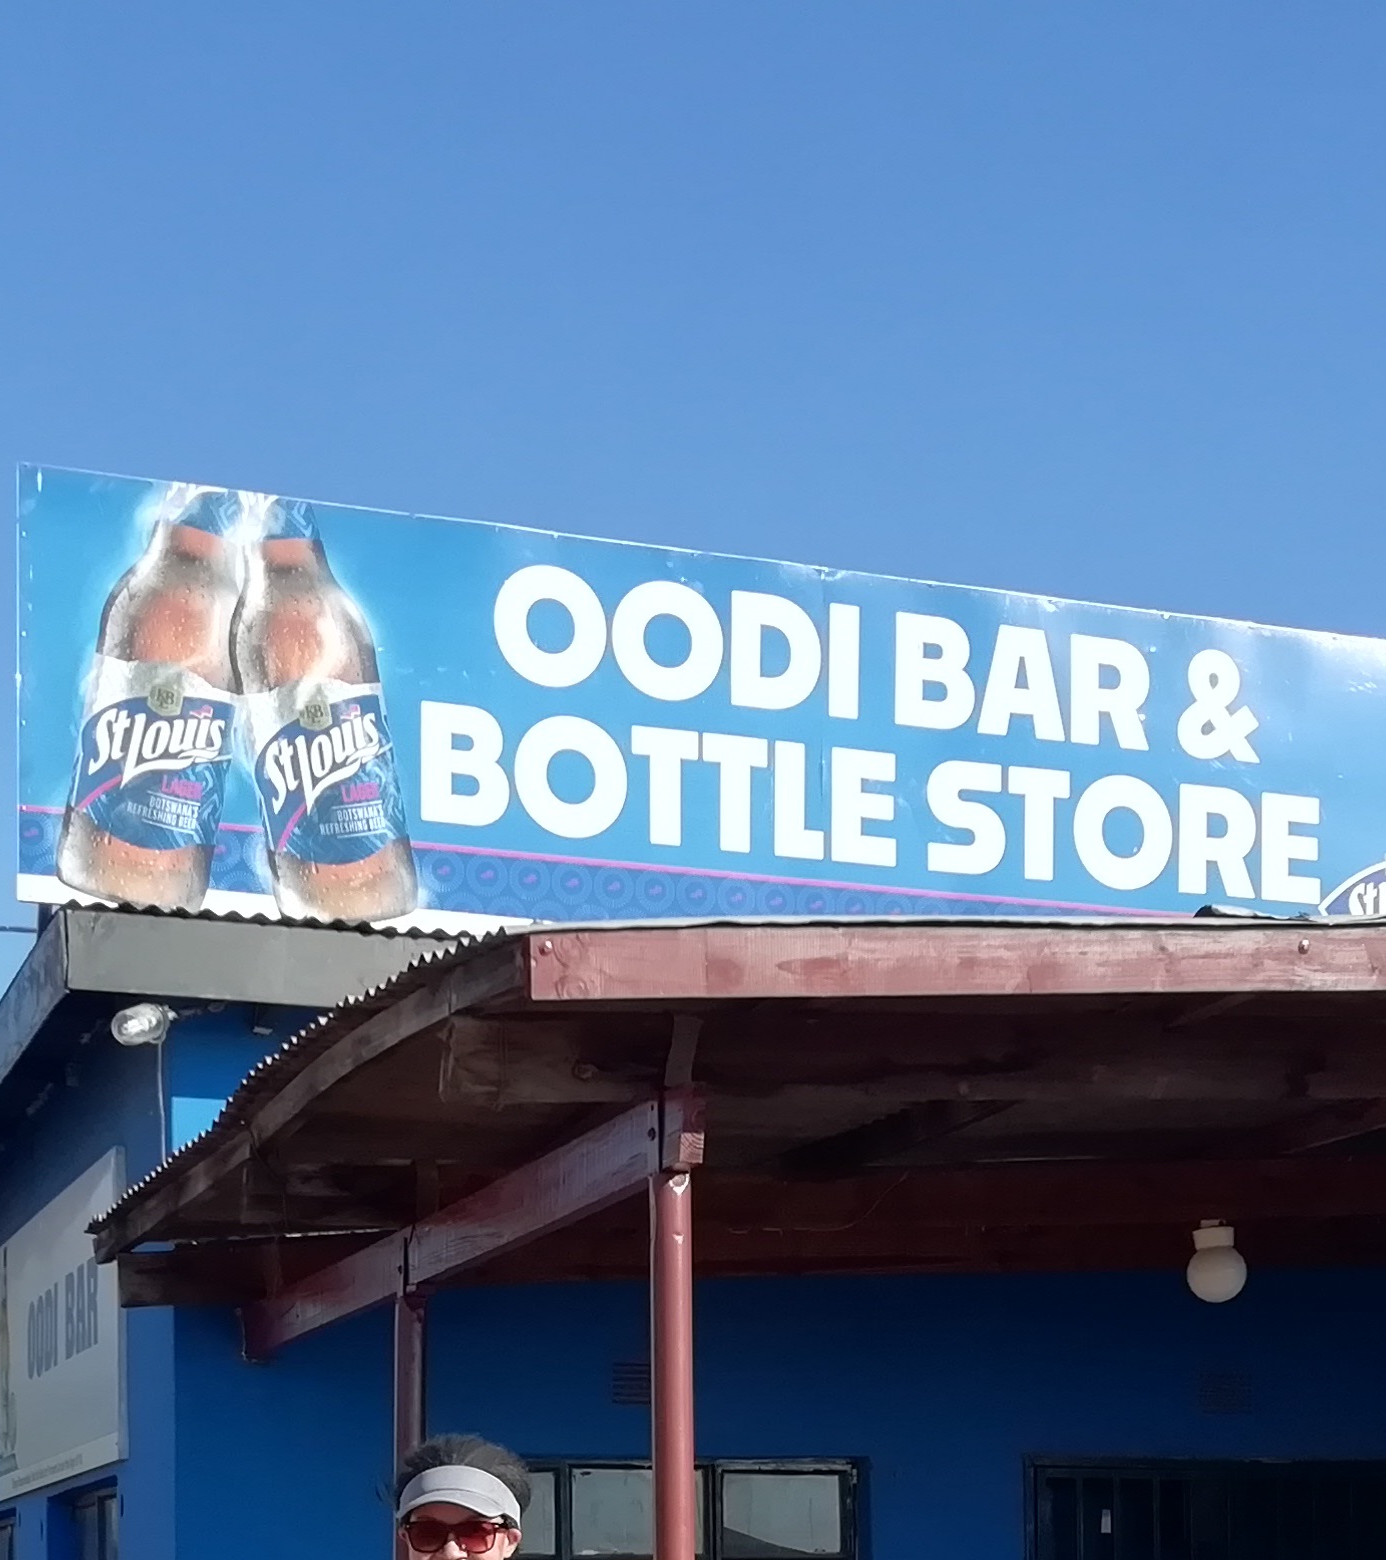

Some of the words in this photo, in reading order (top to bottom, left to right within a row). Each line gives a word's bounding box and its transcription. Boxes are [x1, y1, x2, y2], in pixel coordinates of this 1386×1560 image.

[493, 563, 860, 720] OODI
[894, 610, 1152, 752] BAR
[1176, 648, 1261, 764] &
[127, 801, 177, 827] REFRESHING
[319, 820, 368, 836] REFRESHING
[419, 700, 897, 868] BOTTLE
[926, 758, 1323, 906] STORE
[27, 1281, 59, 1381] OODI
[65, 1256, 99, 1361] BAR
